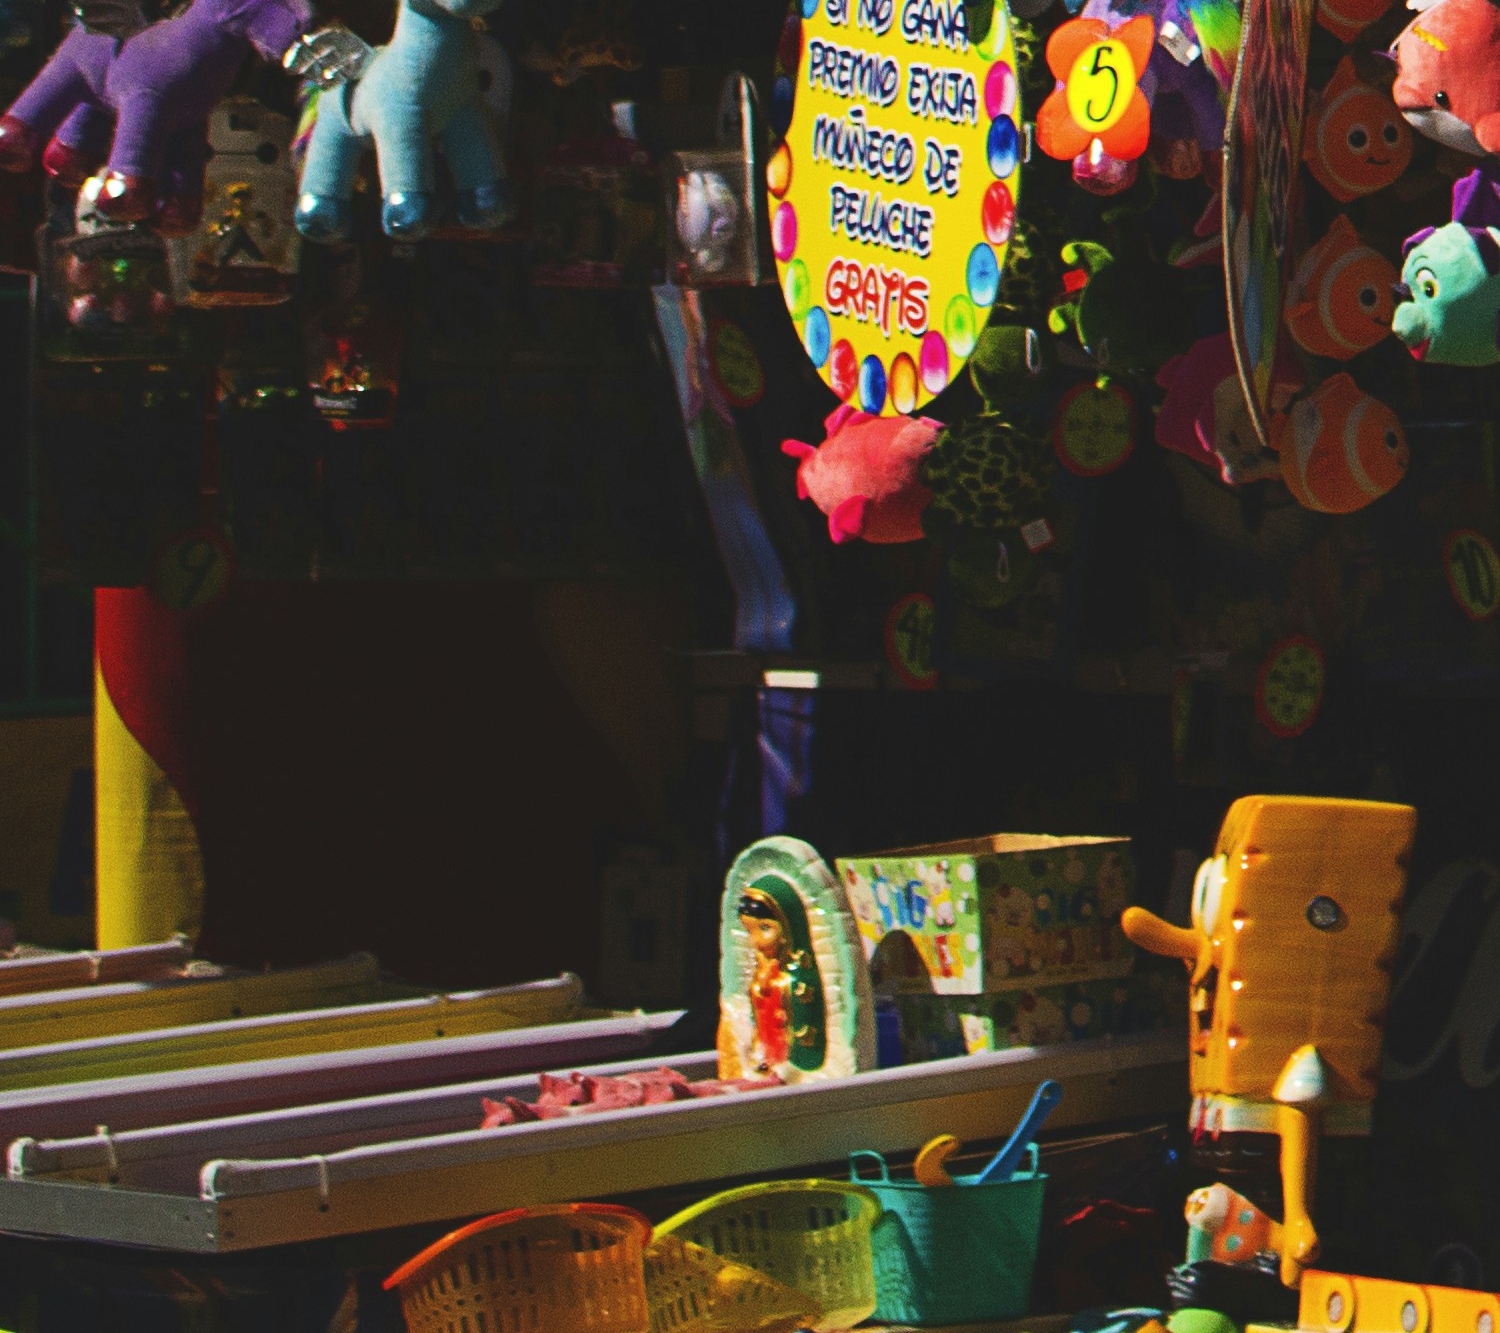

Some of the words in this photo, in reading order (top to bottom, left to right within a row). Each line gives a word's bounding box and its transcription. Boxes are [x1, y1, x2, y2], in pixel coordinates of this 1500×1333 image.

[809, 40, 899, 108] PREMIO
[908, 65, 979, 124] EXIJA
[1087, 46, 1117, 123] 5
[812, 106, 916, 184] MUÑECO
[924, 137, 962, 196] DE
[829, 183, 934, 257] PELUCHE
[825, 256, 930, 338] GRATIS
[178, 540, 218, 611] 9
